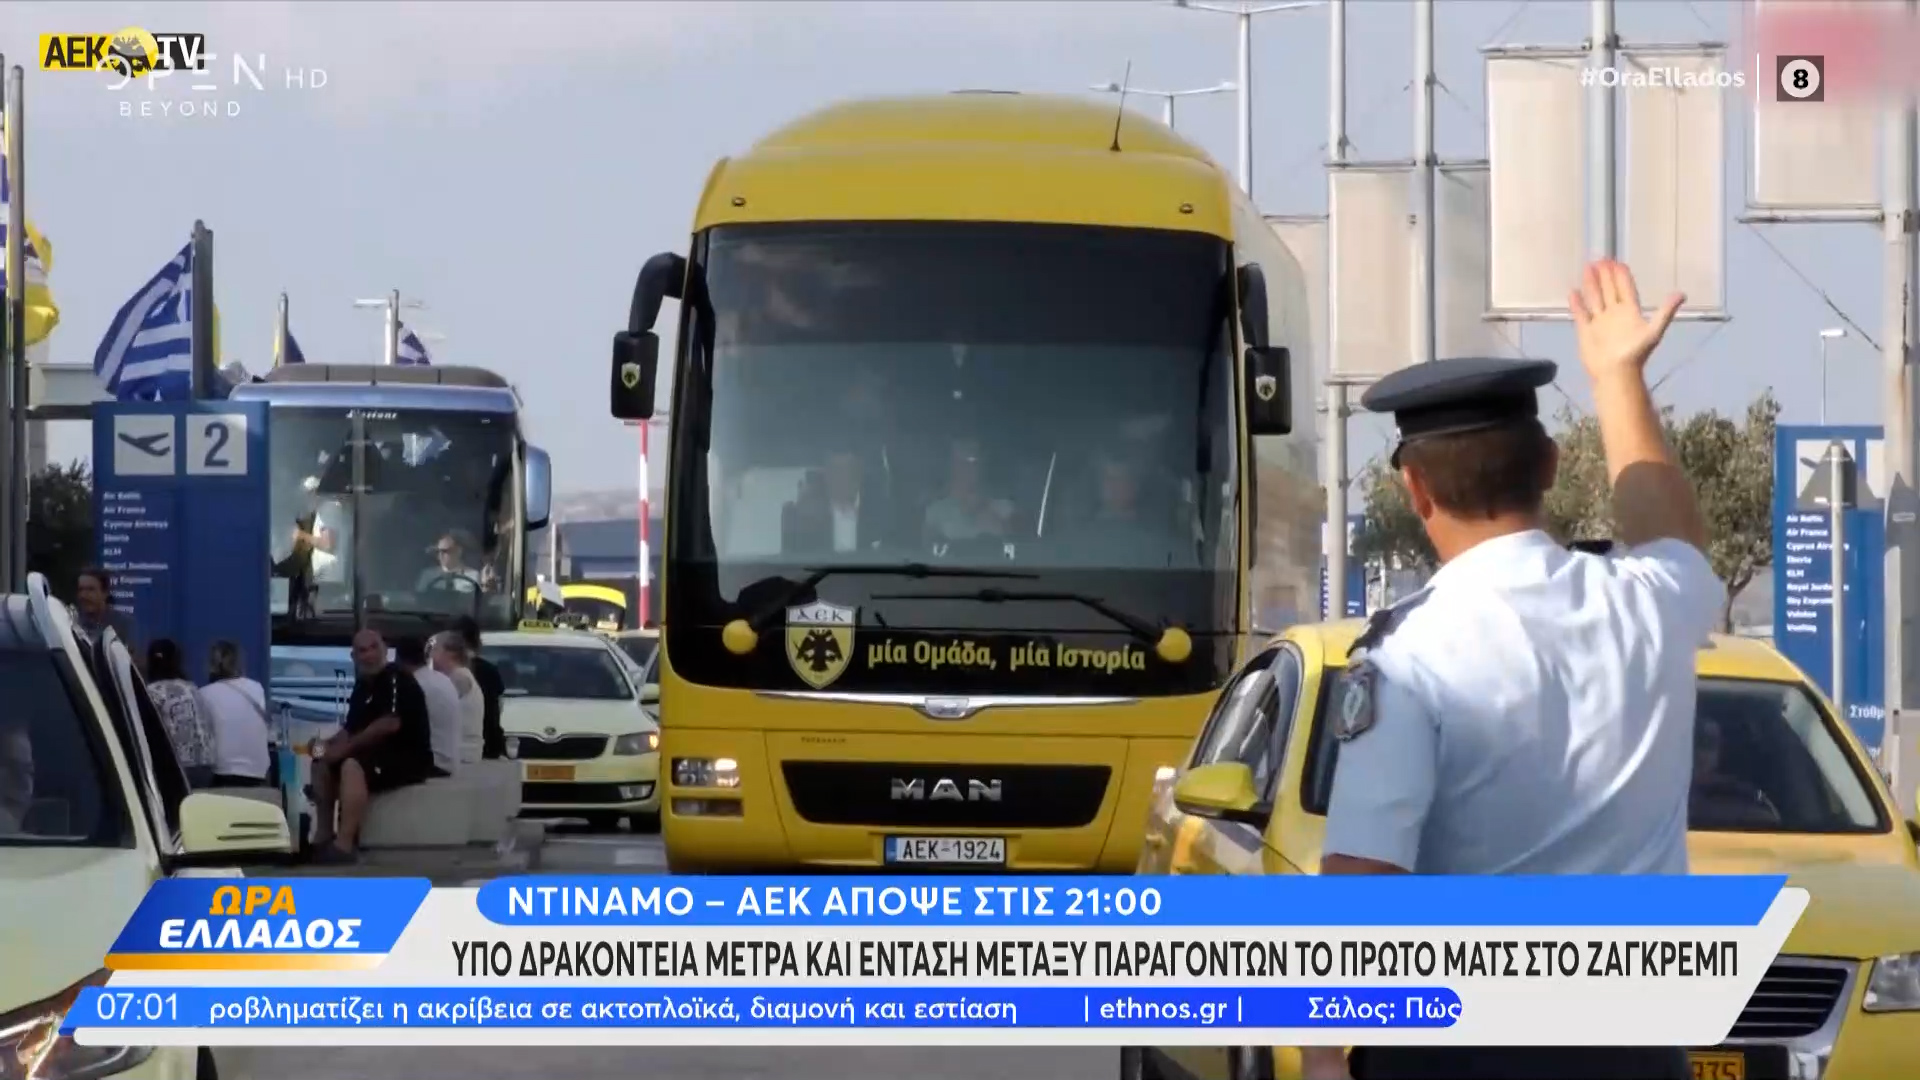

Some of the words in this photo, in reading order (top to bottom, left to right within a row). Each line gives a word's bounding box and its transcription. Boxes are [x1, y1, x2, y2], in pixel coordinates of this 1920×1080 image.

[204, 421, 229, 467] 2
[1056, 643, 1146, 674] Ιστορία
[891, 778, 1002, 801] MAN
